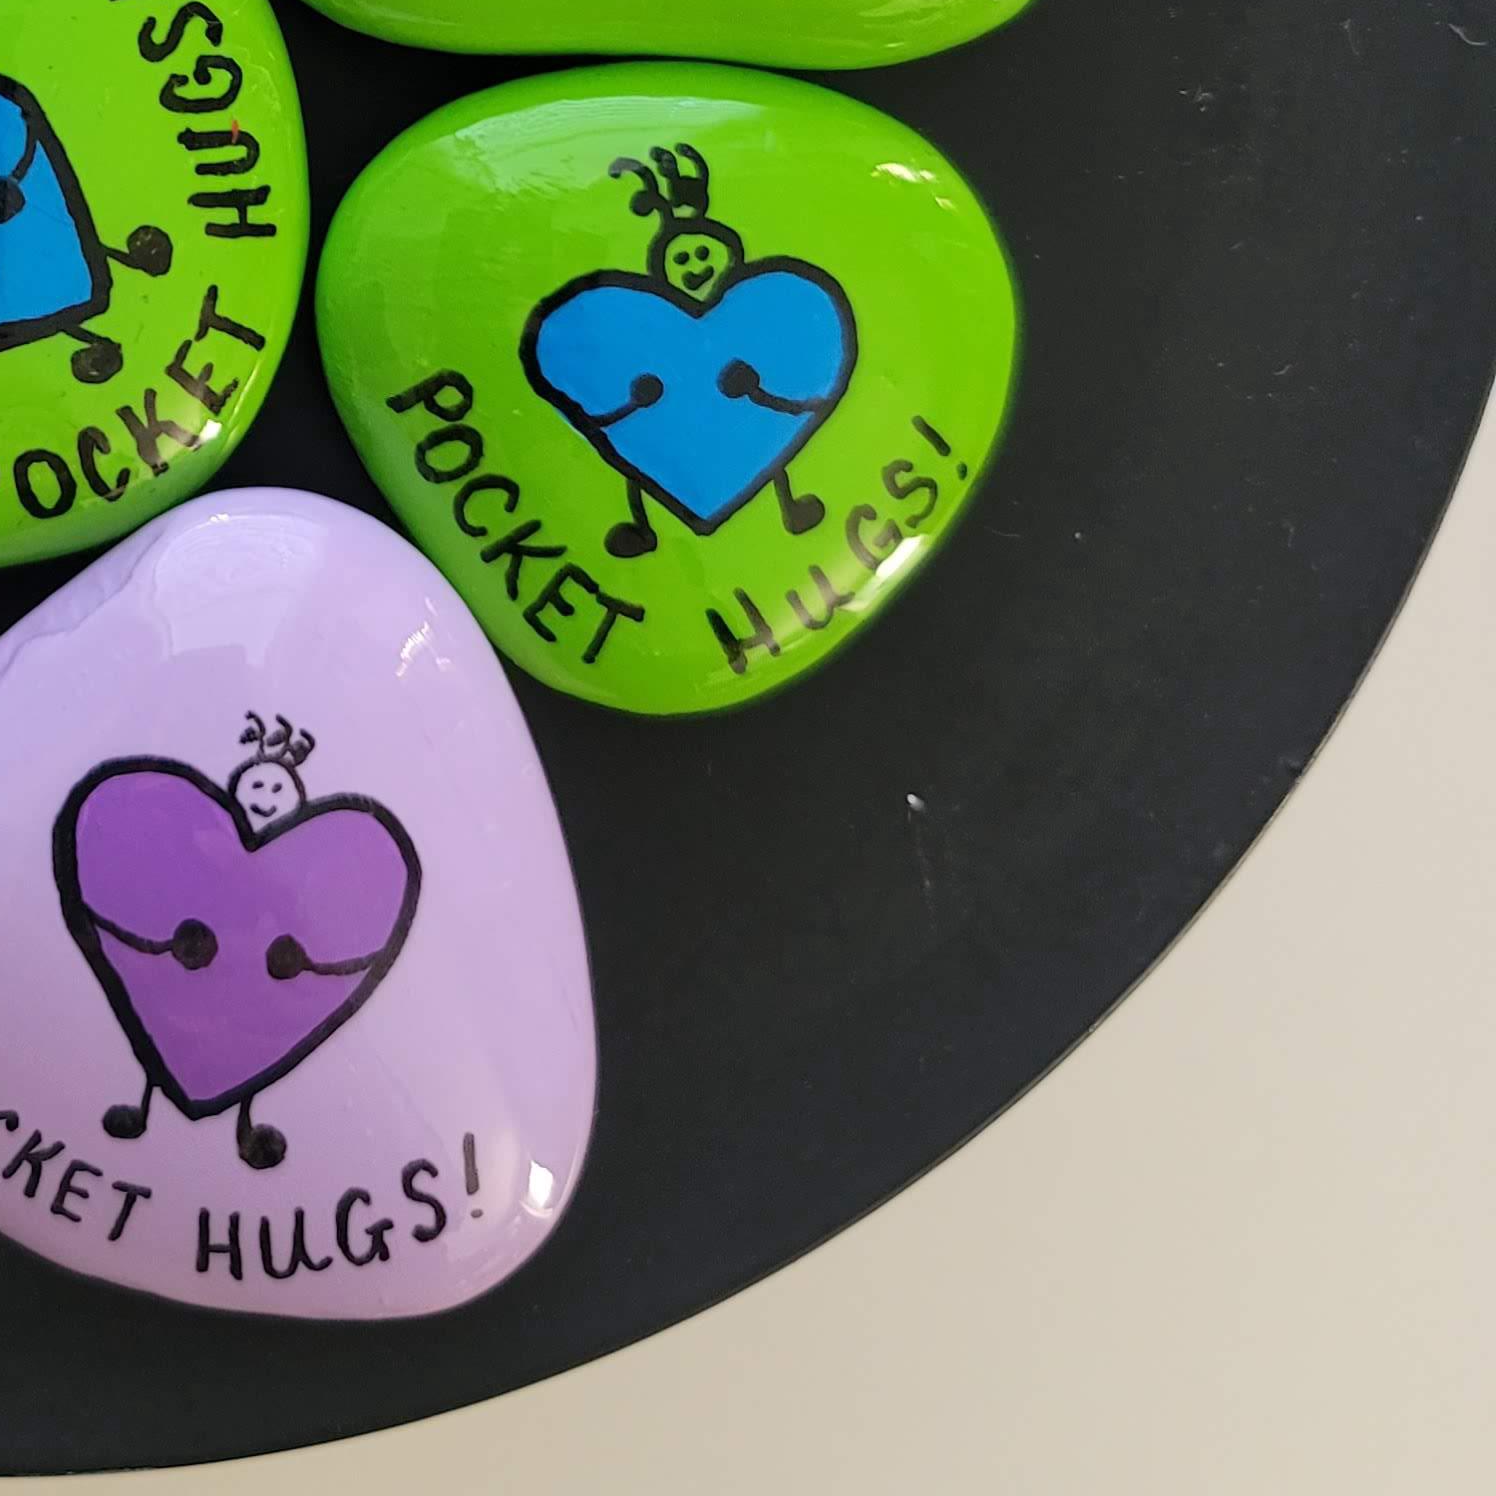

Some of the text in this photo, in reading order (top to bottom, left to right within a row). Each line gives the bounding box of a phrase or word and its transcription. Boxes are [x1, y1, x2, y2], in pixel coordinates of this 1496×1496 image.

[385, 369, 969, 675] POCKET HUGS!
[194, 1131, 485, 1282] HUGS!
